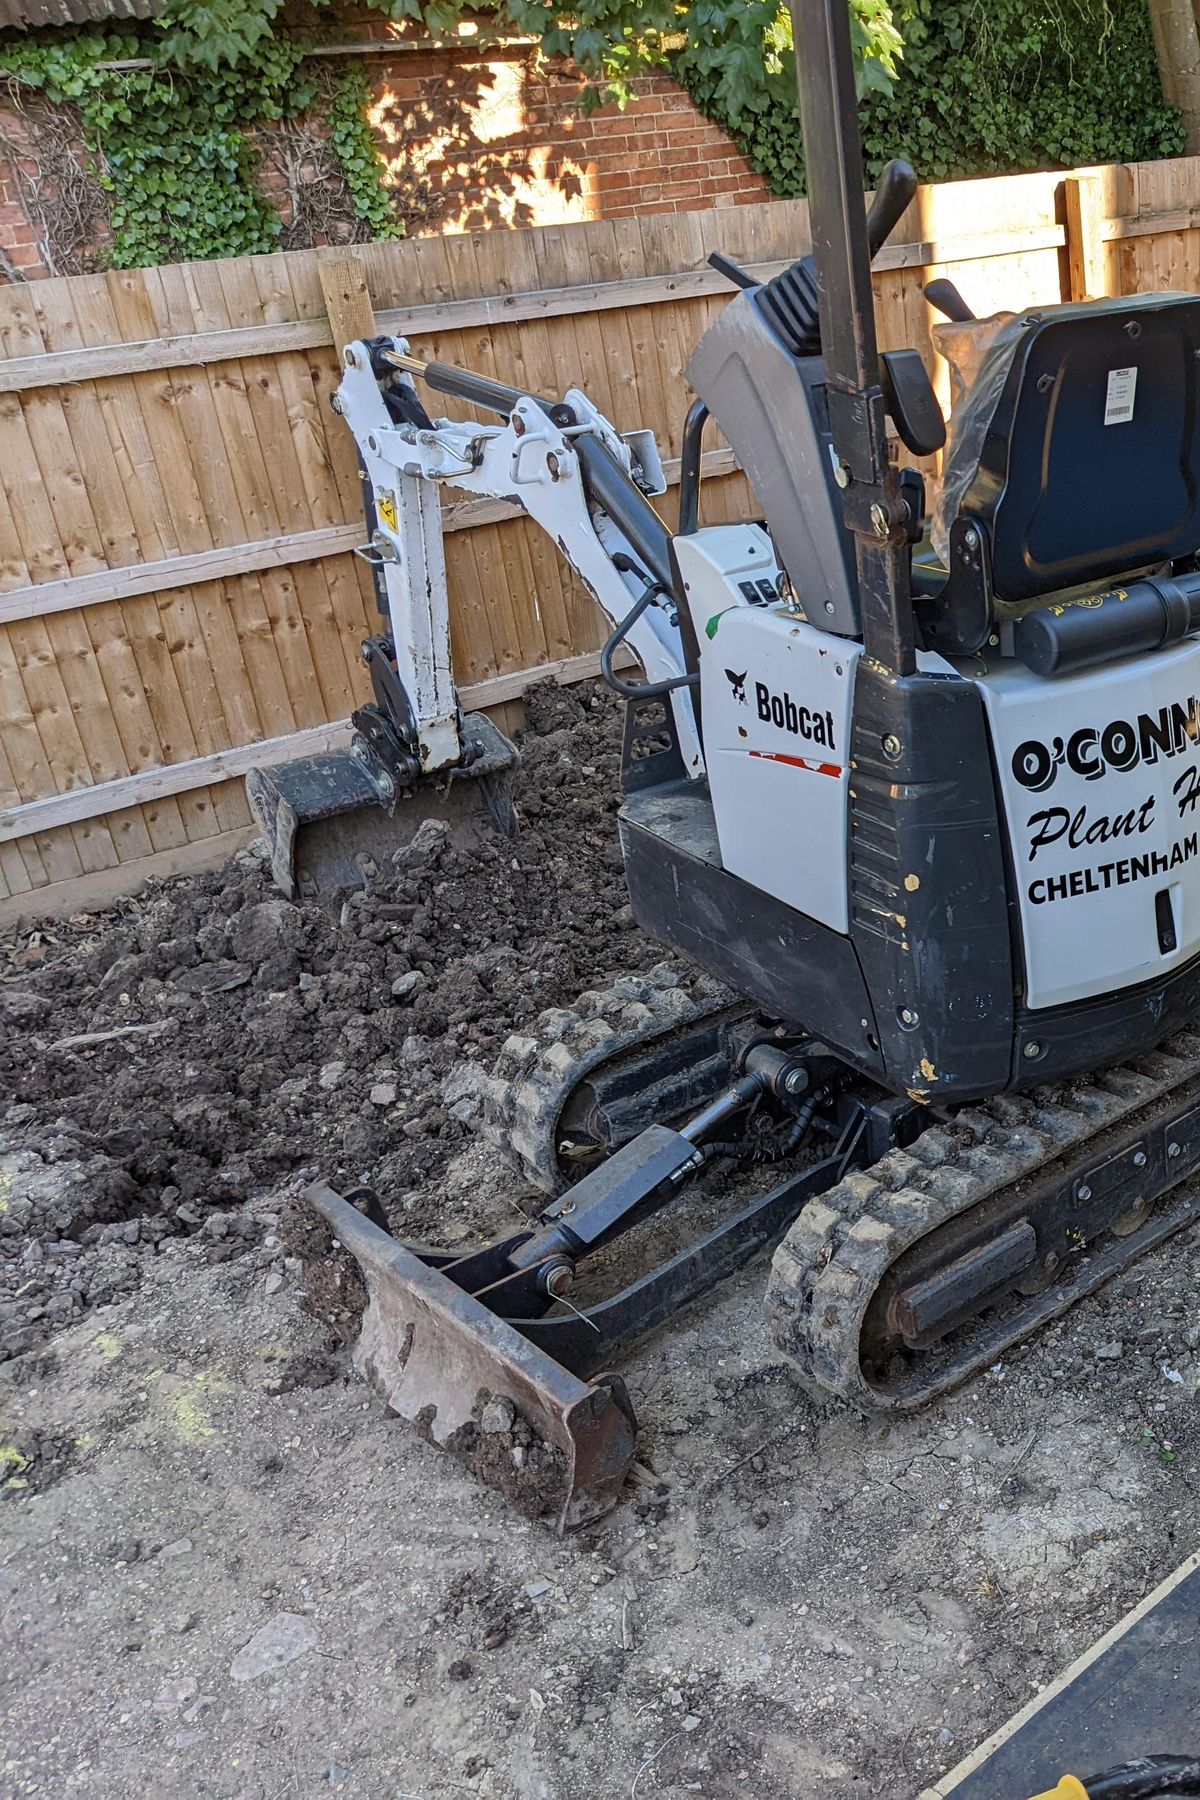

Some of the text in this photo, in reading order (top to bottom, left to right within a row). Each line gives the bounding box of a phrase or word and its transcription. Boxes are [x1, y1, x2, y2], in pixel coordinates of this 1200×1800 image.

[755, 681, 836, 750] Bobcat
[1026, 794, 1156, 862] Plant
[1027, 831, 1198, 905] CHELTENHAM
